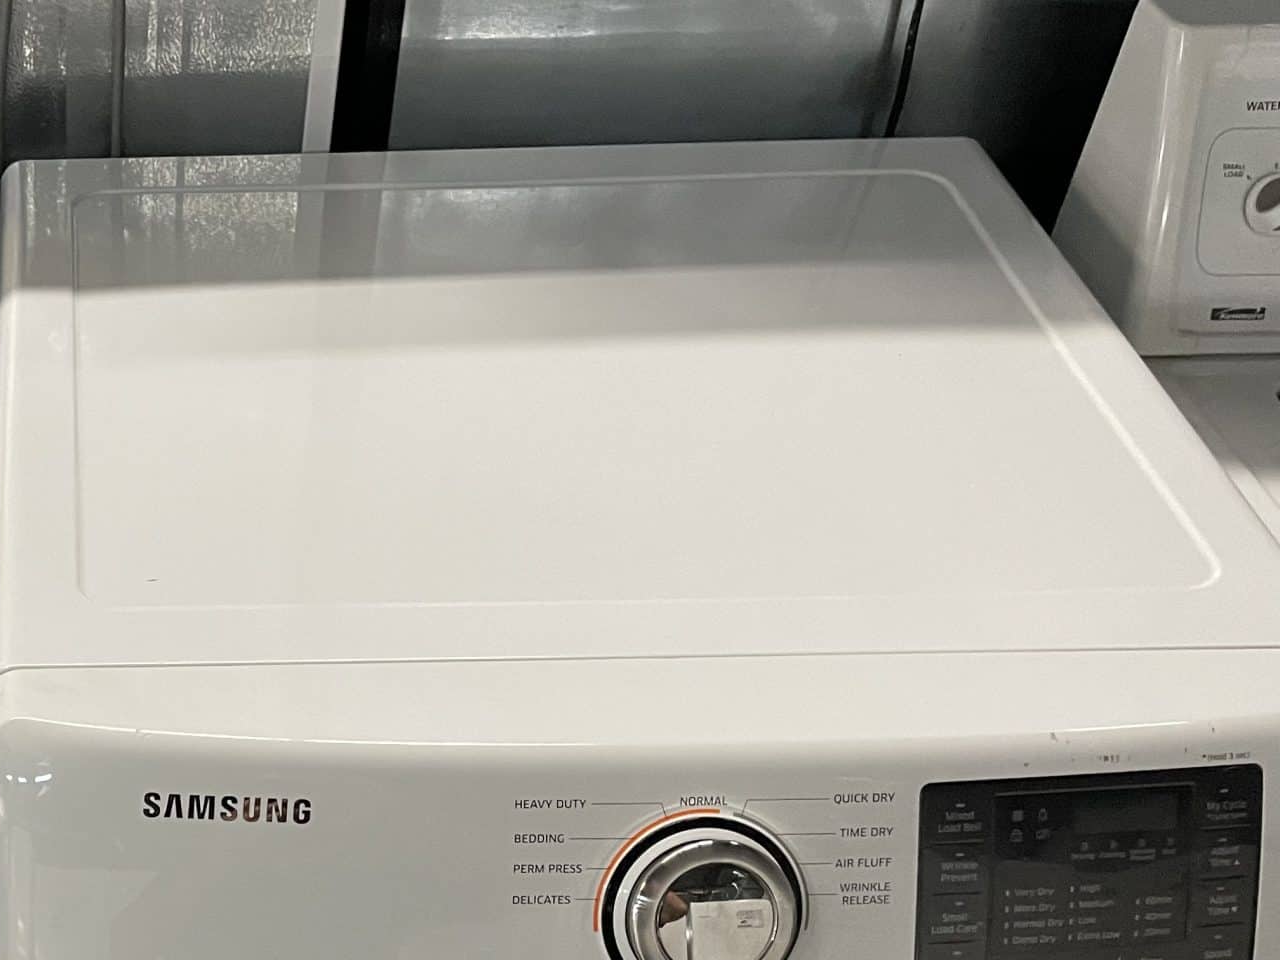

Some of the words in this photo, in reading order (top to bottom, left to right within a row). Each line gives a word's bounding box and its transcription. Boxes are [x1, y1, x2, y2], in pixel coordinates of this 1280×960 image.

[514, 799, 552, 809] HEAVY
[555, 798, 587, 809] DUTY
[680, 795, 728, 807] NORMAL
[833, 792, 867, 804] QUICK
[869, 791, 896, 803] DRY
[142, 792, 313, 825] SAMSUNG
[839, 827, 865, 838] TIME
[866, 826, 894, 838] DRY
[513, 833, 565, 844] BEDDING
[512, 863, 546, 875] PERM
[548, 863, 583, 874] PRESS
[835, 858, 853, 869] AIR
[855, 857, 893, 869] FLUFF
[839, 882, 892, 893] WRINKLE
[511, 894, 571, 905] DELICATES
[841, 894, 891, 905] RELEASE
